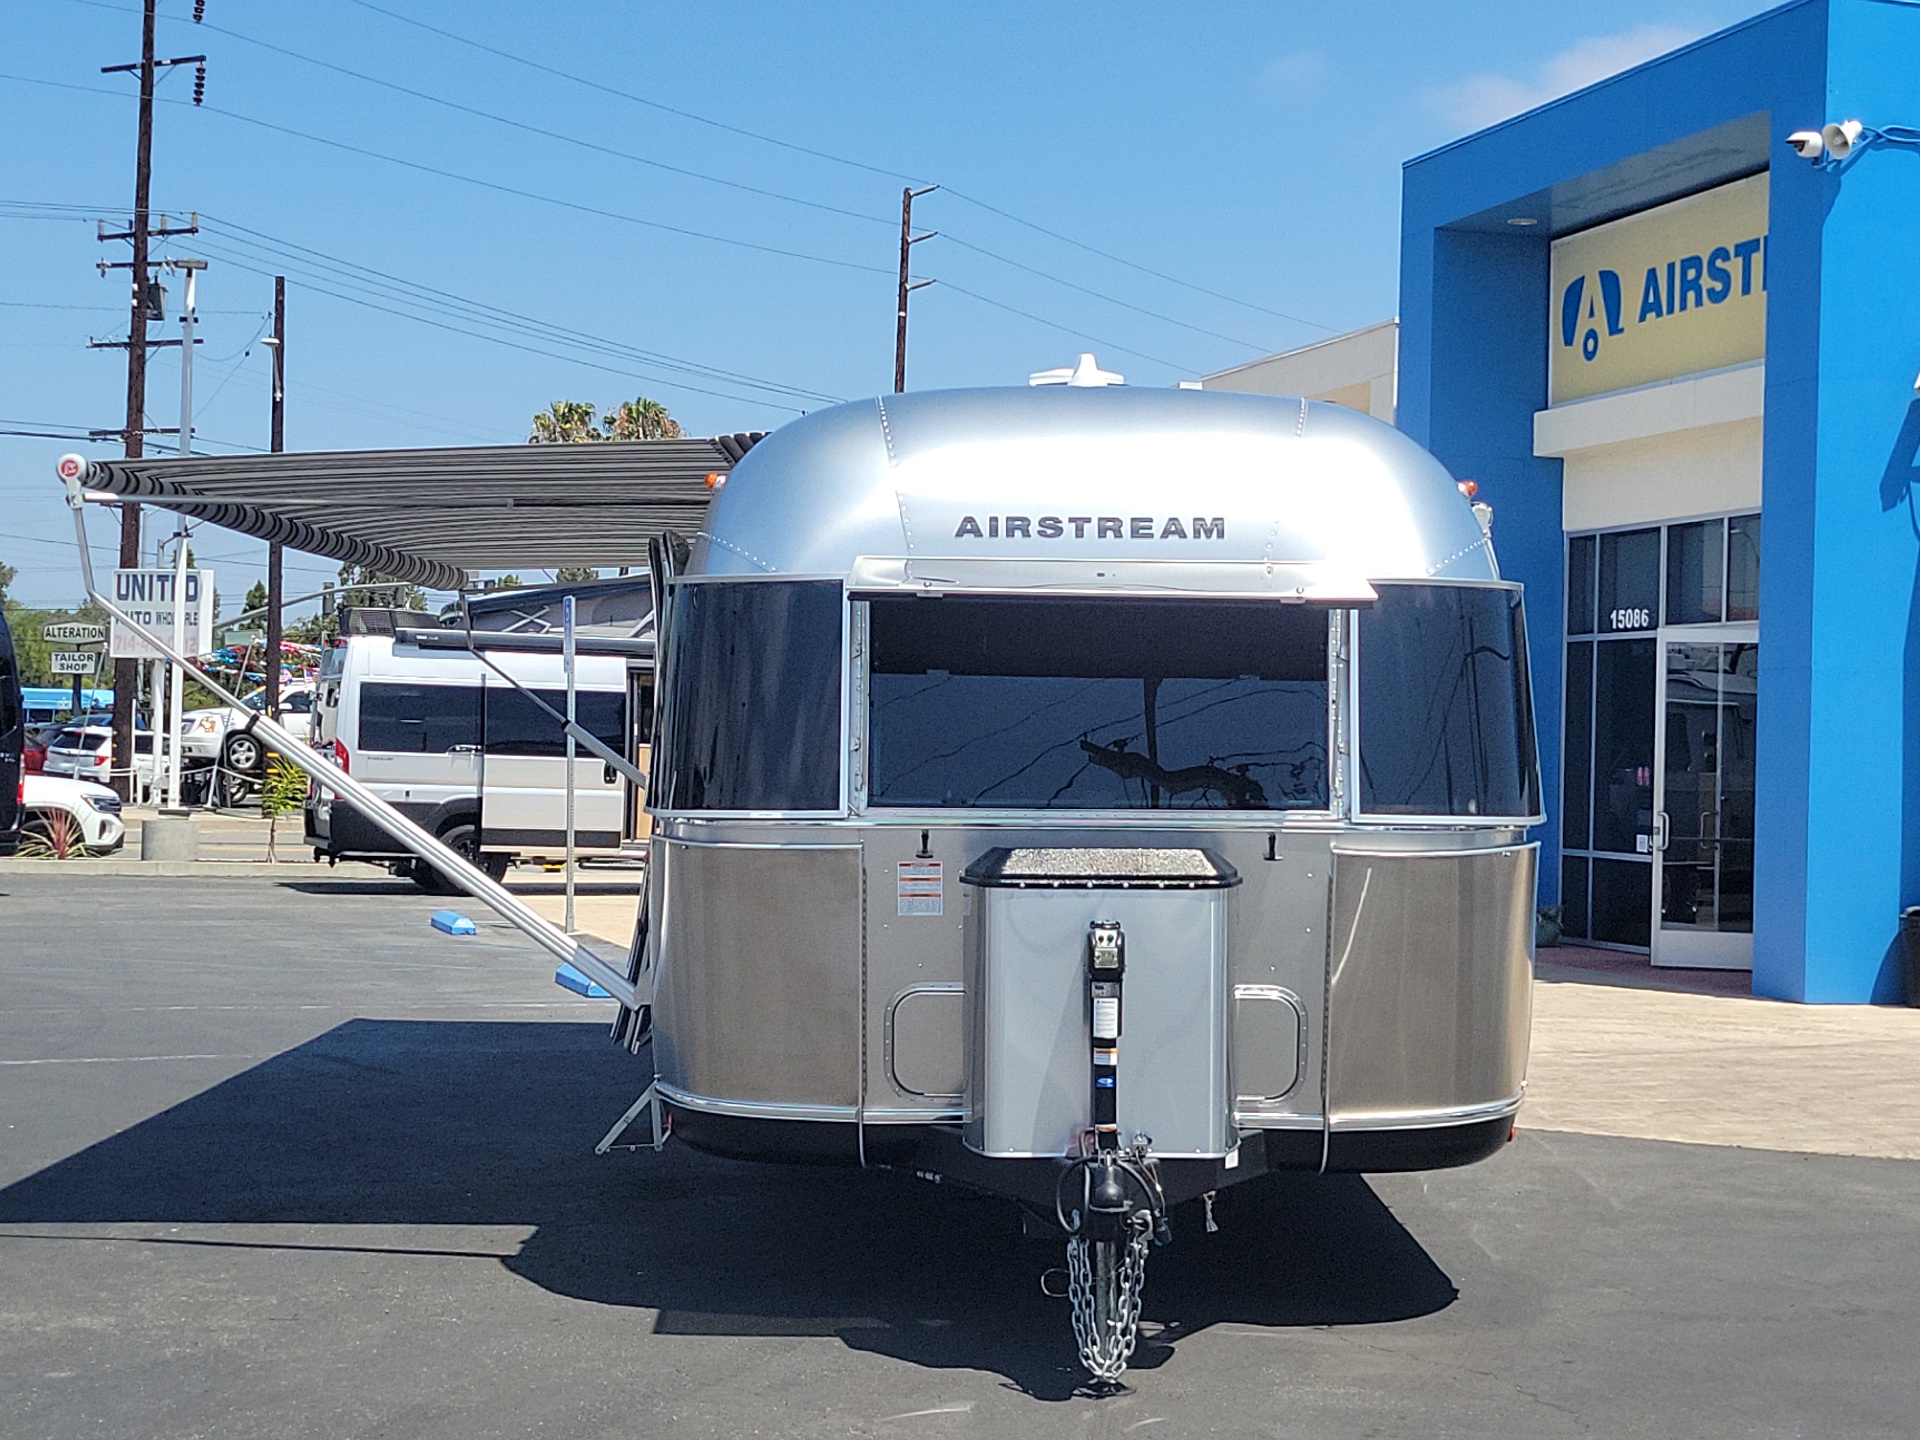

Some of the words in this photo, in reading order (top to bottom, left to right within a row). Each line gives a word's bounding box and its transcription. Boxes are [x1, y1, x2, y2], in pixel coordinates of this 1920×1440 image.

[1638, 234, 1767, 323] AIRST
[954, 516, 1225, 539] AIRSTREAM
[1610, 608, 1649, 629] 15086
[45, 626, 105, 639] ALTERATION
[54, 653, 95, 662] TAILOR
[59, 663, 88, 671] SHOP
